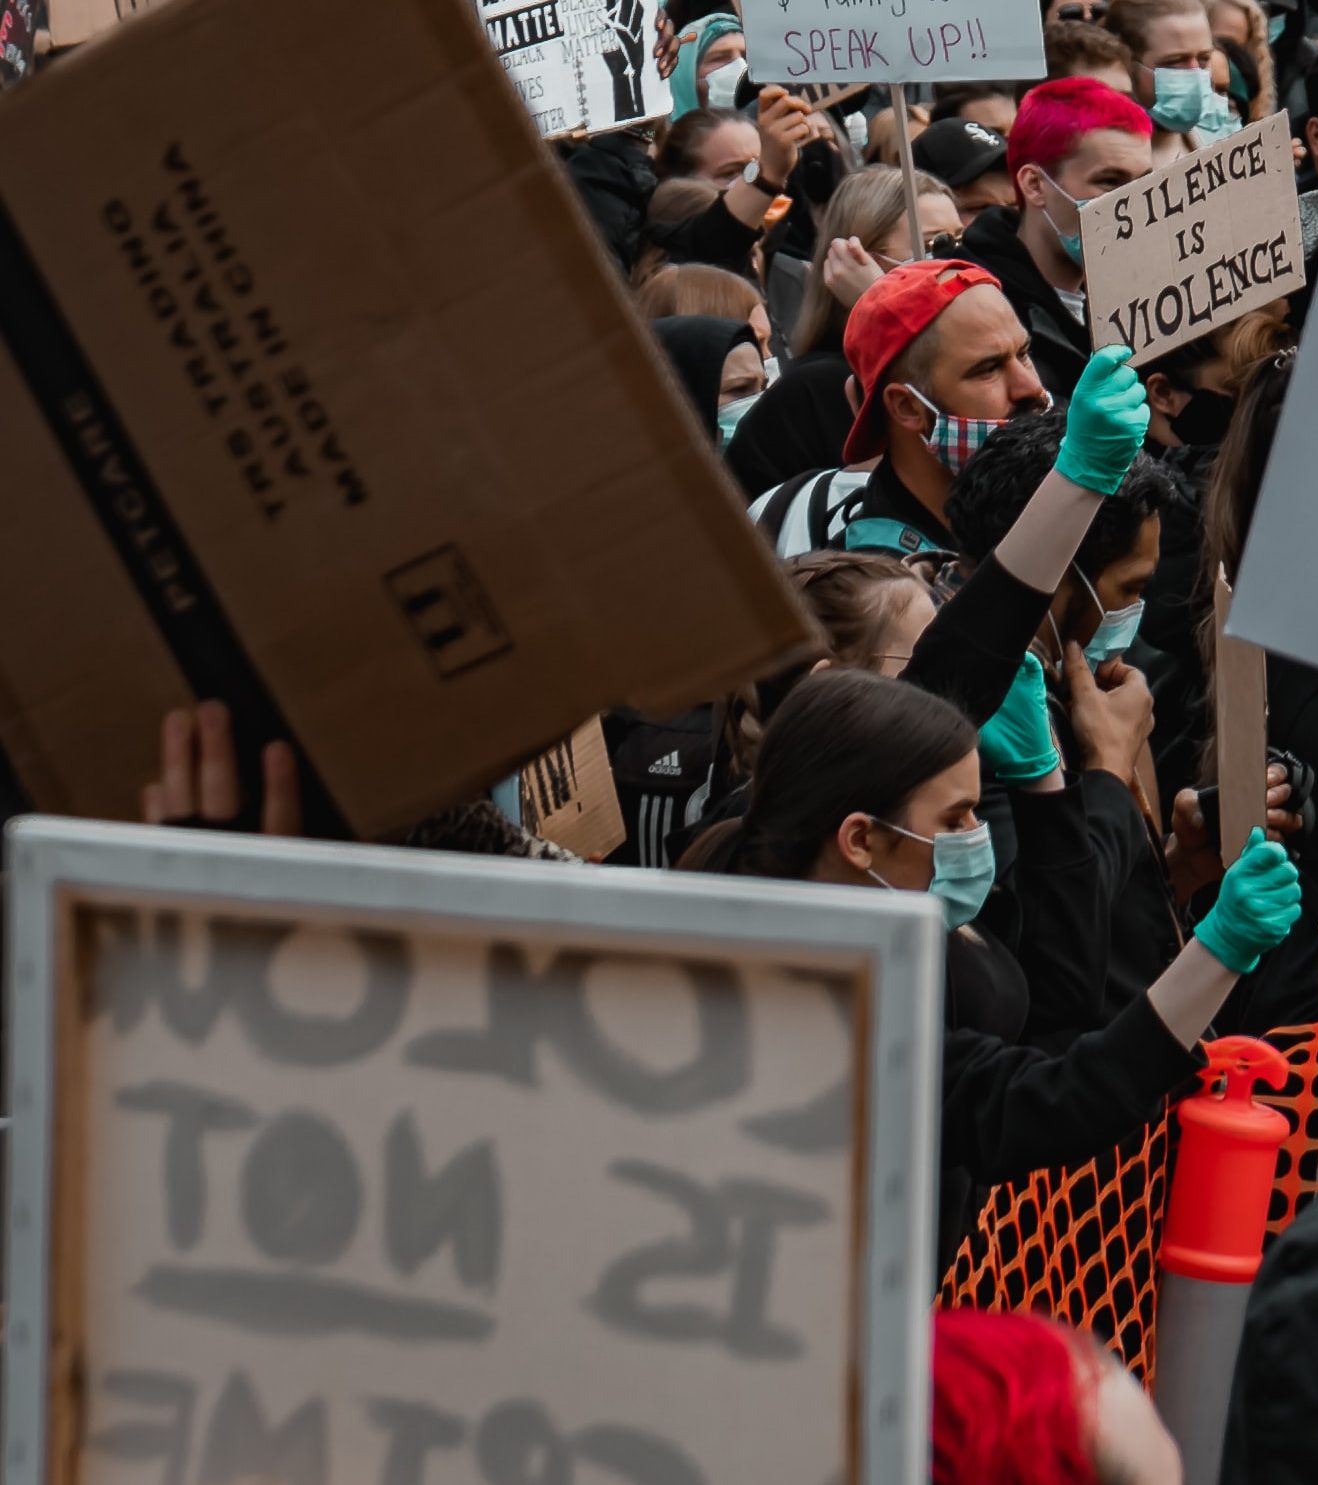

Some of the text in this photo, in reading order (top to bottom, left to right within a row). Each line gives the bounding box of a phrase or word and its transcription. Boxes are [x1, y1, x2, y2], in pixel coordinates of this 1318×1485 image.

[784, 18, 987, 76] SPEAK UP!!
[512, 75, 544, 101] IVES
[1114, 132, 1267, 241] SILENCE
[1175, 220, 1206, 262] IS
[1108, 230, 1294, 355] VIOLENCE
